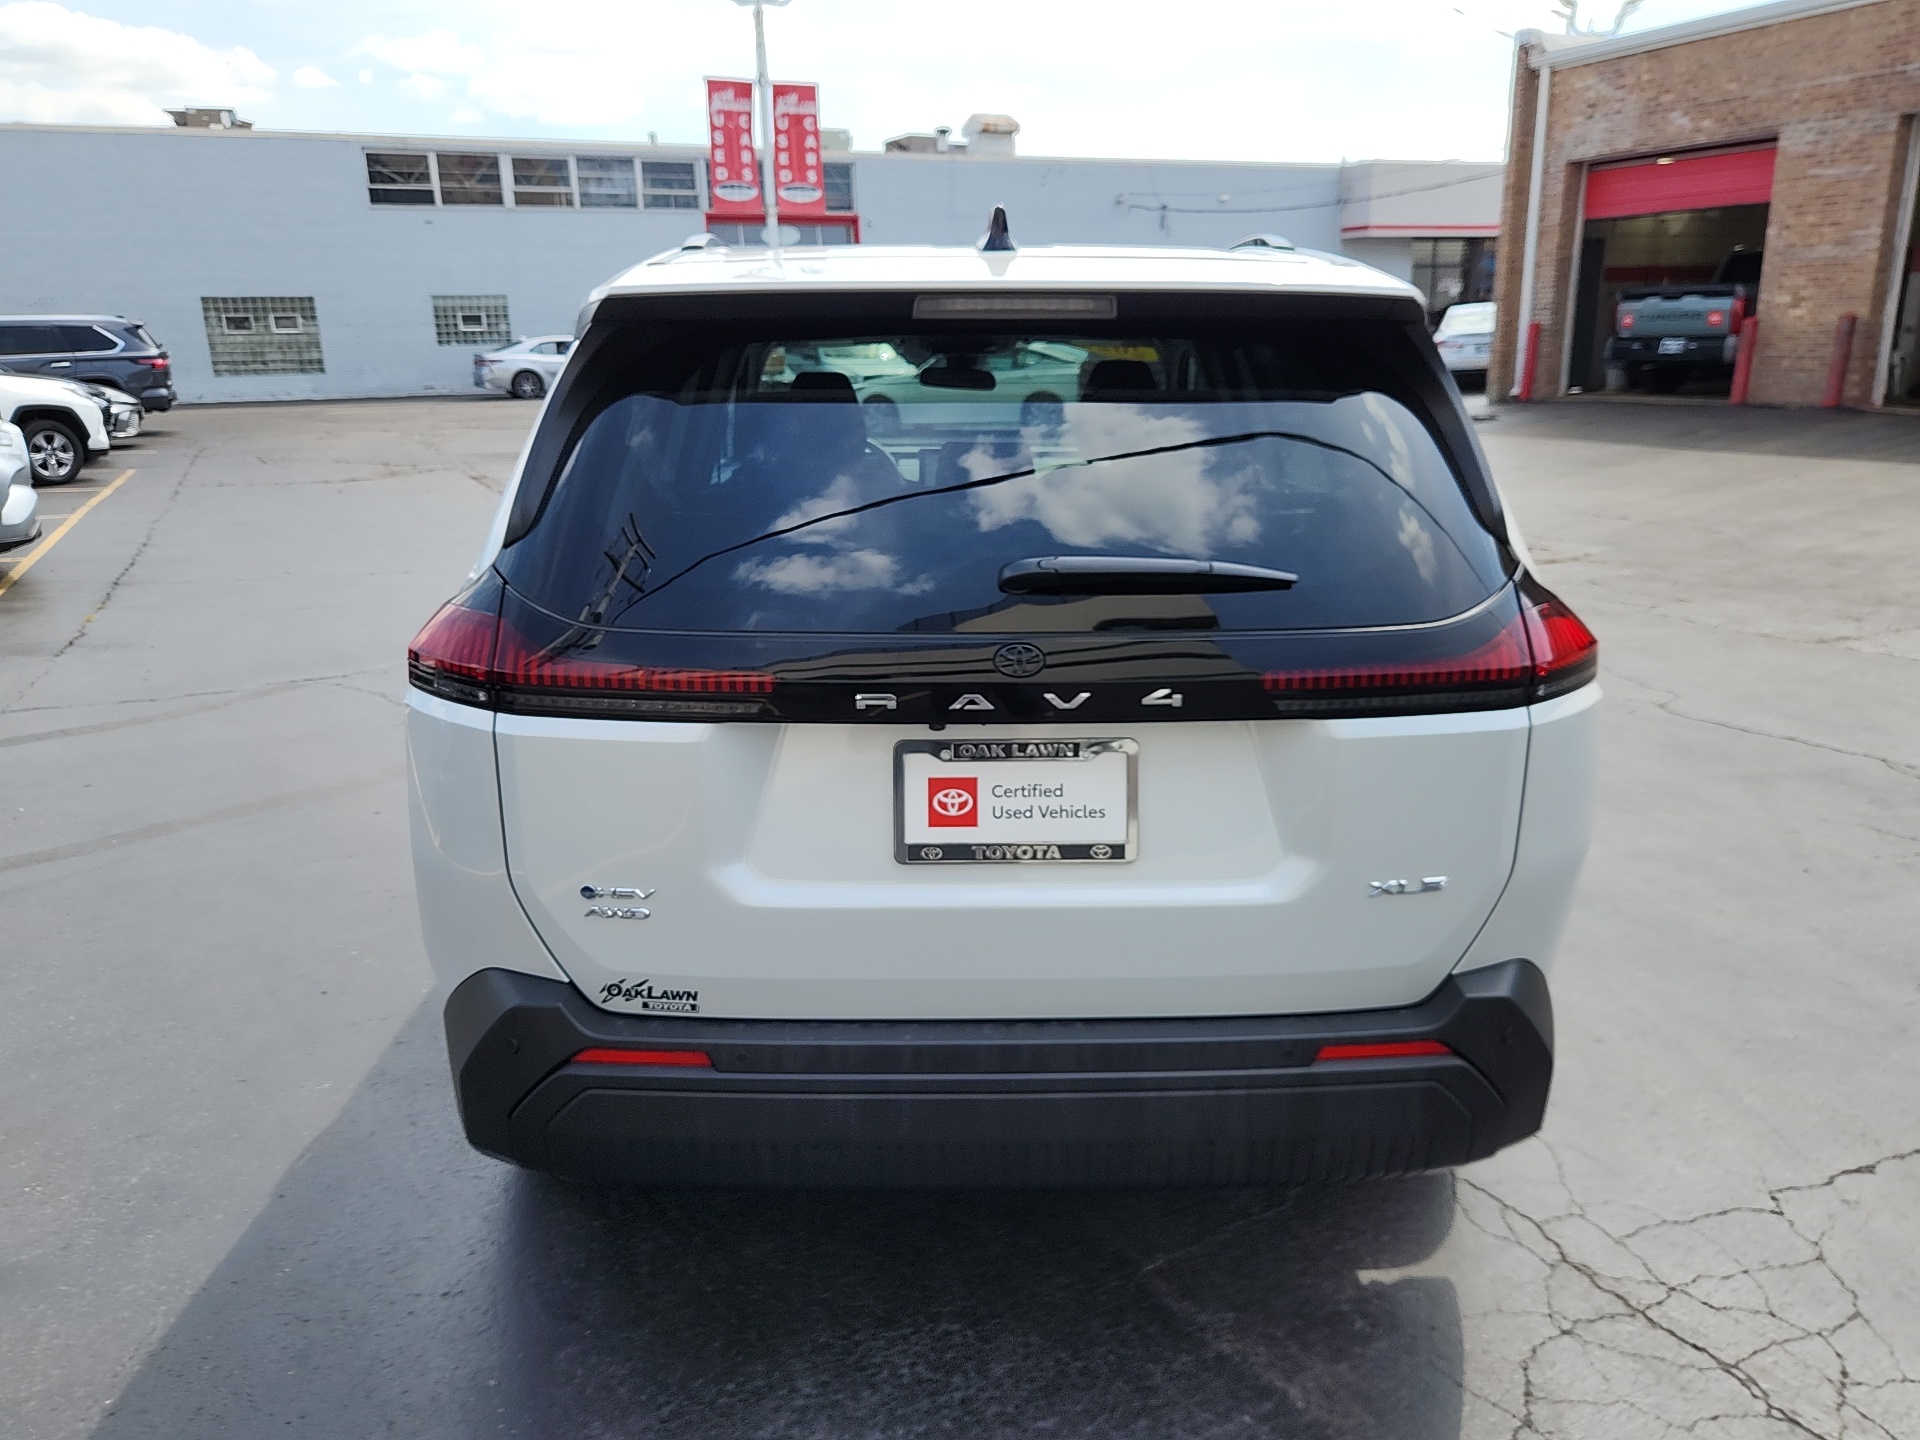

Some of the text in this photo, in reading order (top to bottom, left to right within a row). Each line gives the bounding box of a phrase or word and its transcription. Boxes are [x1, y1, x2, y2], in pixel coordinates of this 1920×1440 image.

[958, 743, 1075, 758] OAK LAWN
[991, 783, 1064, 799] Certified
[992, 804, 1107, 819] Used Vehicles
[971, 845, 1063, 860] TOYOTA
[584, 905, 651, 920] AWD
[649, 1001, 692, 1011] TOYOTA
